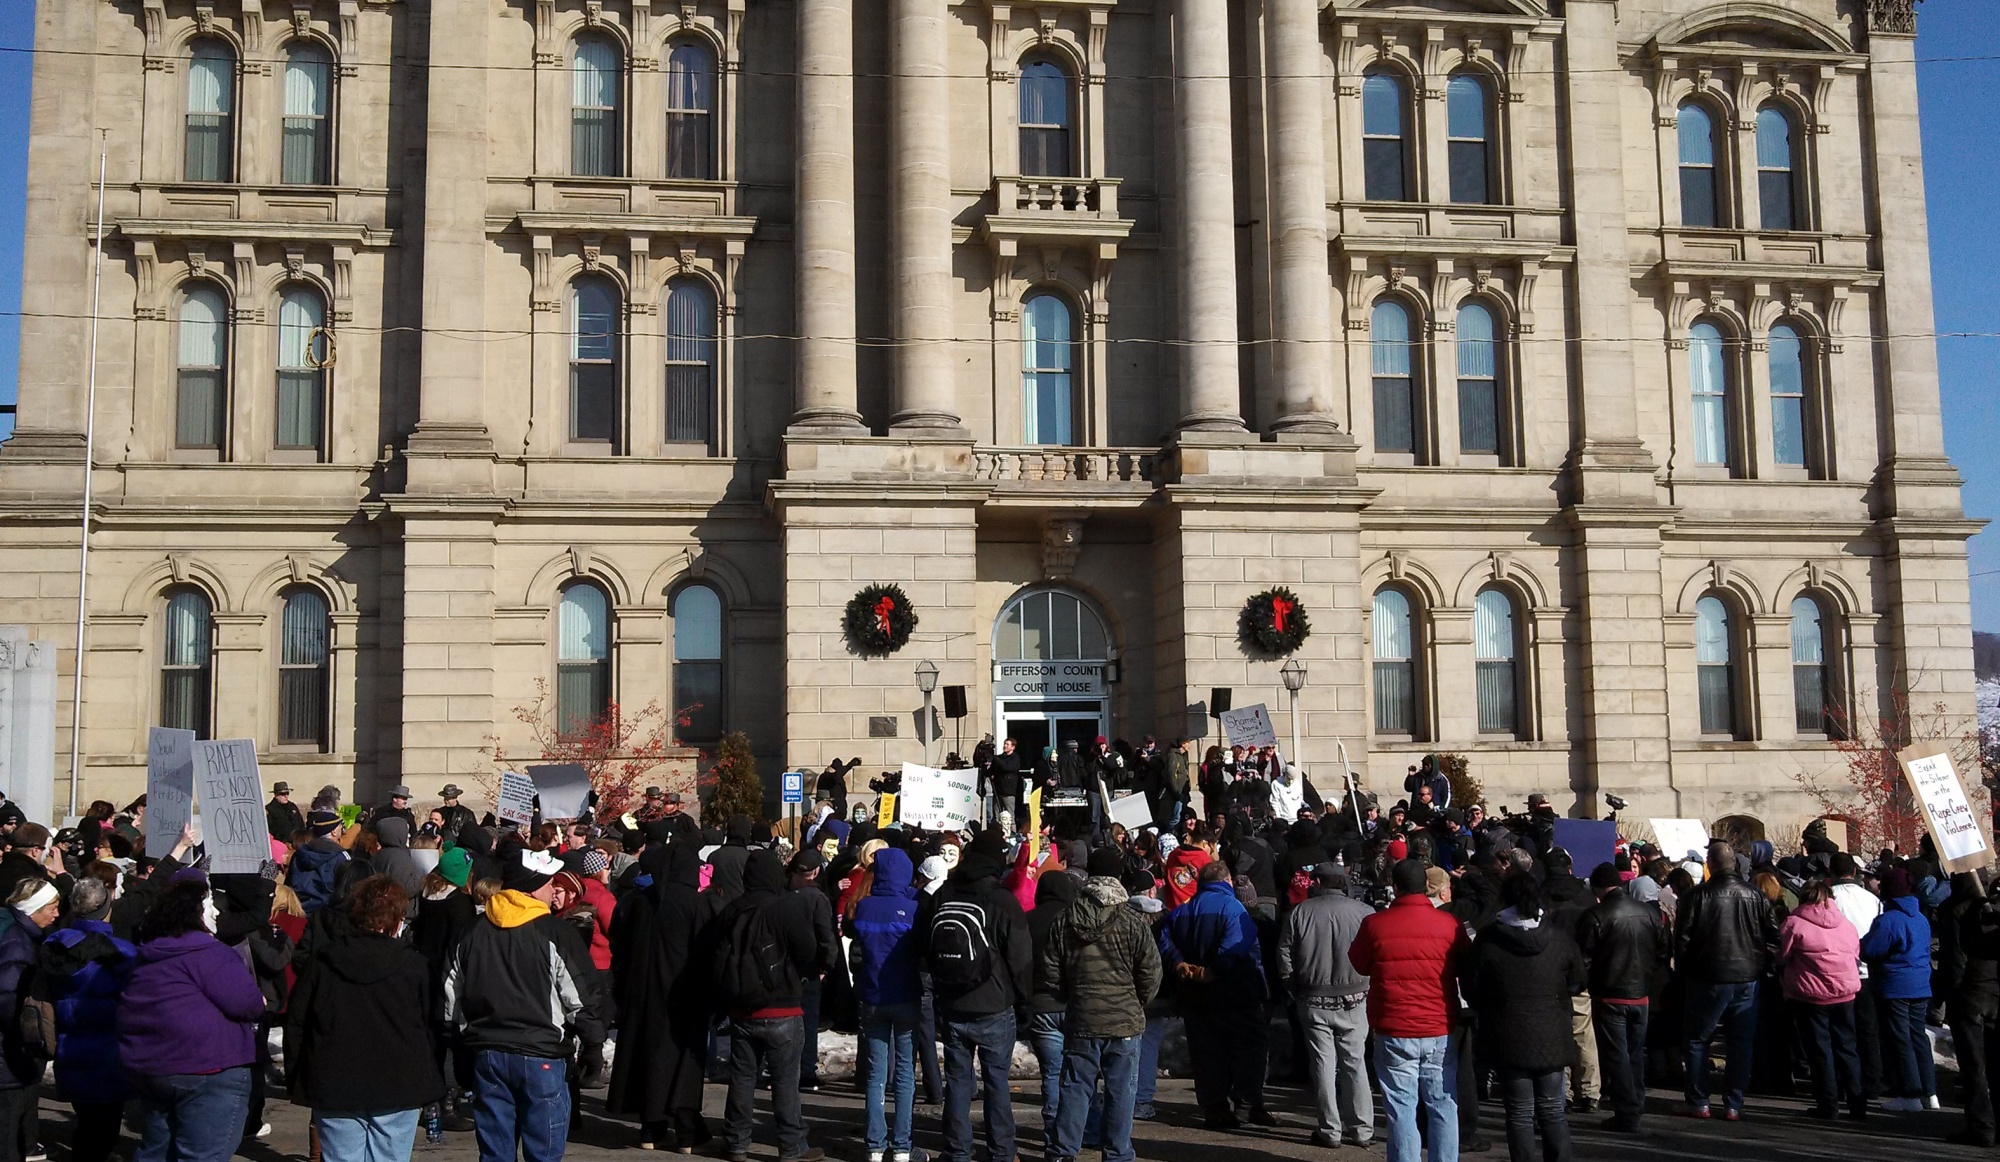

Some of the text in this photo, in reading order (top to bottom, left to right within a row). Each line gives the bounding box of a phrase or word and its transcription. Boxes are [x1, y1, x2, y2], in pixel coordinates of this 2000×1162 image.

[1001, 665, 1105, 676] JEFFERSON COUNTY
[1013, 682, 1091, 693] COURT HOUSE
[204, 744, 243, 775] RAPE
[908, 775, 923, 784] RAPE
[207, 776, 255, 800] IS NOT
[947, 780, 973, 793] SODOMY
[502, 807, 516, 818] SAY
[946, 812, 967, 823] ABUSE
[1928, 803, 1952, 825] Rape
[214, 807, 257, 845] OKAY
[1941, 814, 1977, 836] Violence!
